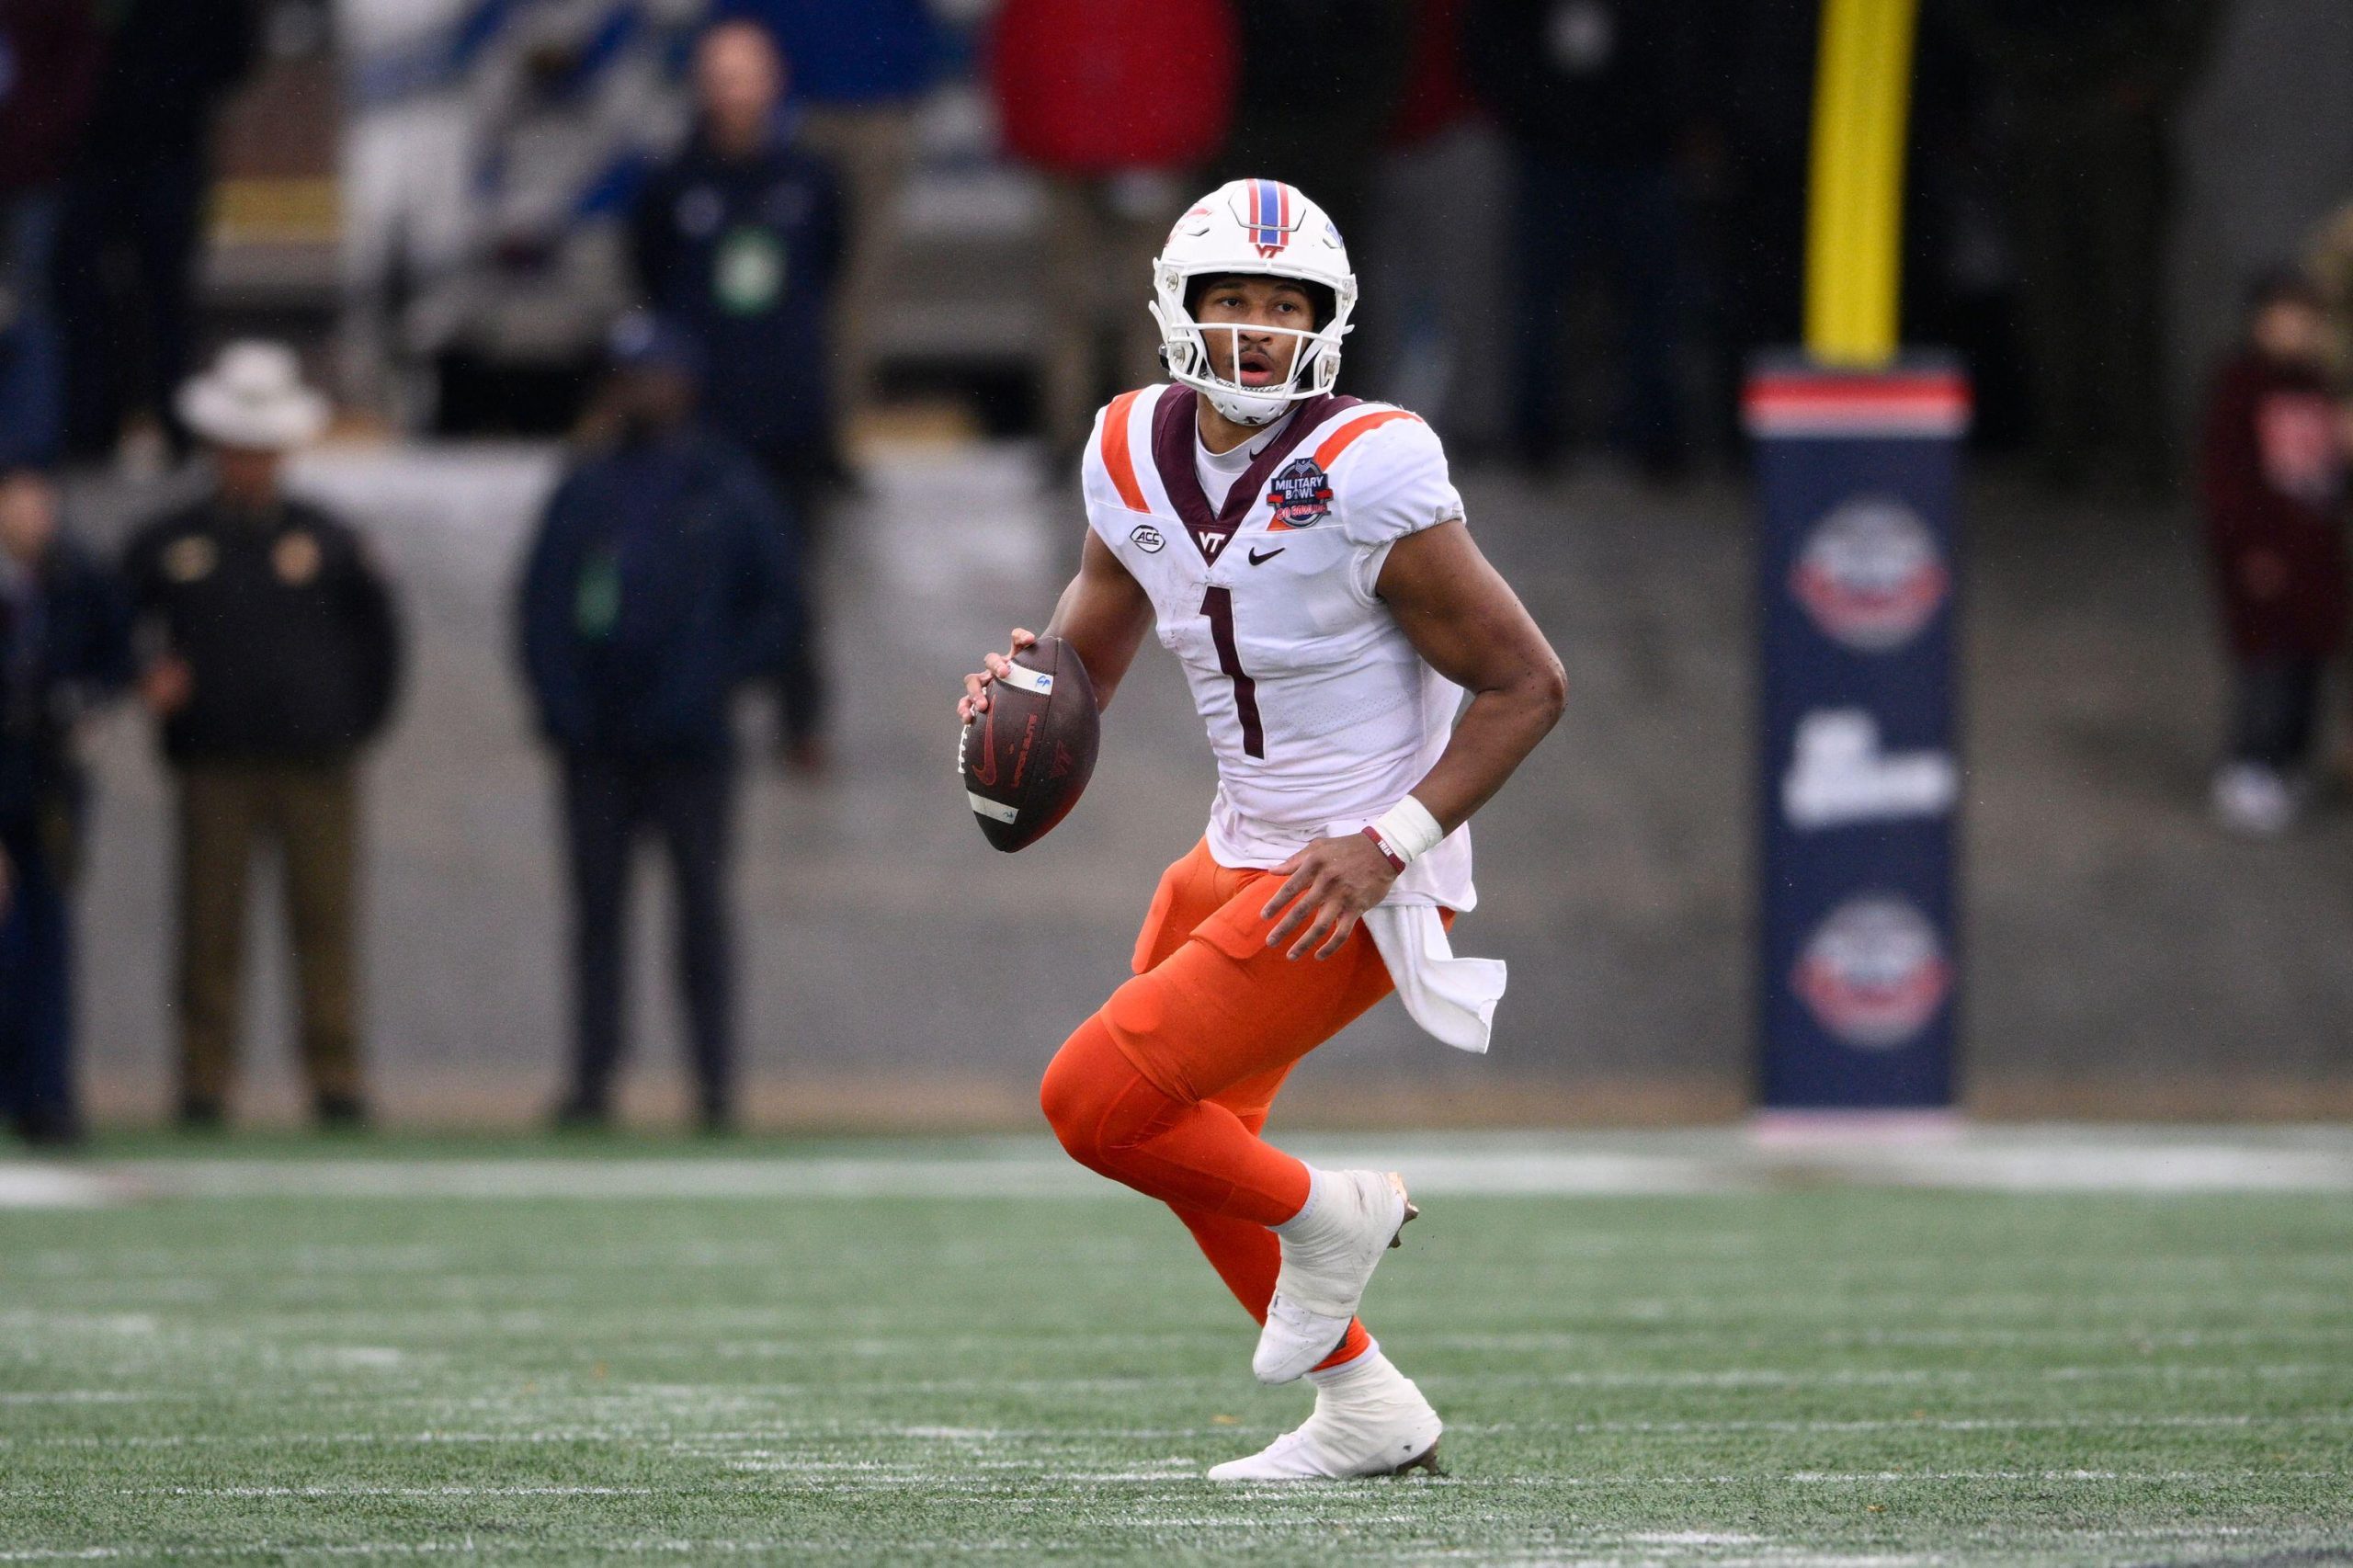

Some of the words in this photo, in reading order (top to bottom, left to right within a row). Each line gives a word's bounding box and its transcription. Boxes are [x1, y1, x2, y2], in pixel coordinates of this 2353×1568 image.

[1255, 244, 1285, 258] VT
[1275, 475, 1324, 491] MILITARY
[1136, 531, 1160, 543] ACC
[1199, 531, 1226, 553] VT
[1199, 585, 1266, 761] 1
